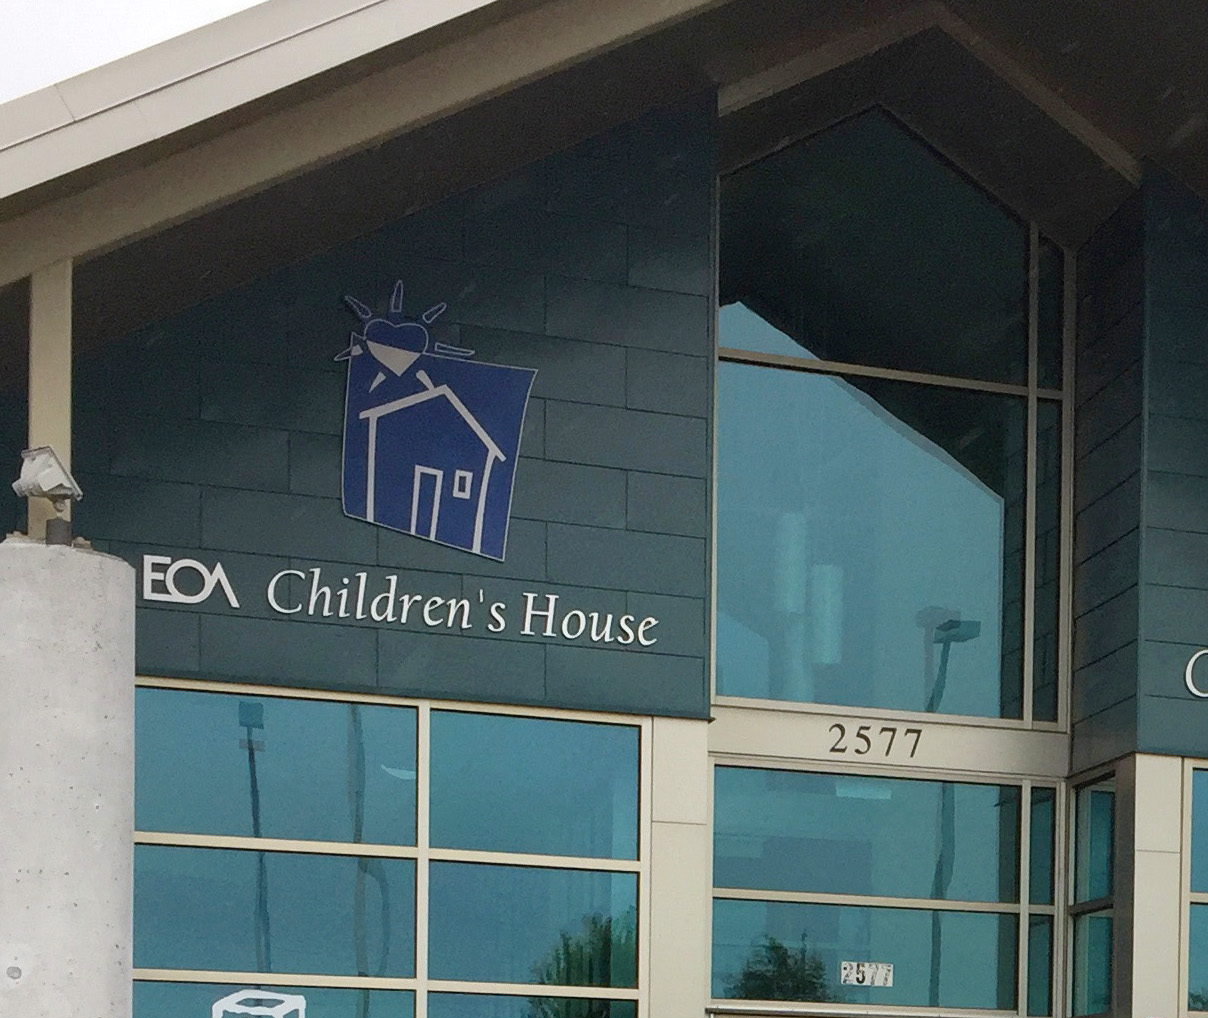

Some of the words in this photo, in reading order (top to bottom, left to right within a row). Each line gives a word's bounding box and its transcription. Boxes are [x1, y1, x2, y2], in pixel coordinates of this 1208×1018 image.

[267, 567, 506, 633] Children's
[520, 592, 659, 647] House
[828, 723, 923, 758] 2577
[841, 961, 893, 987] 2577
